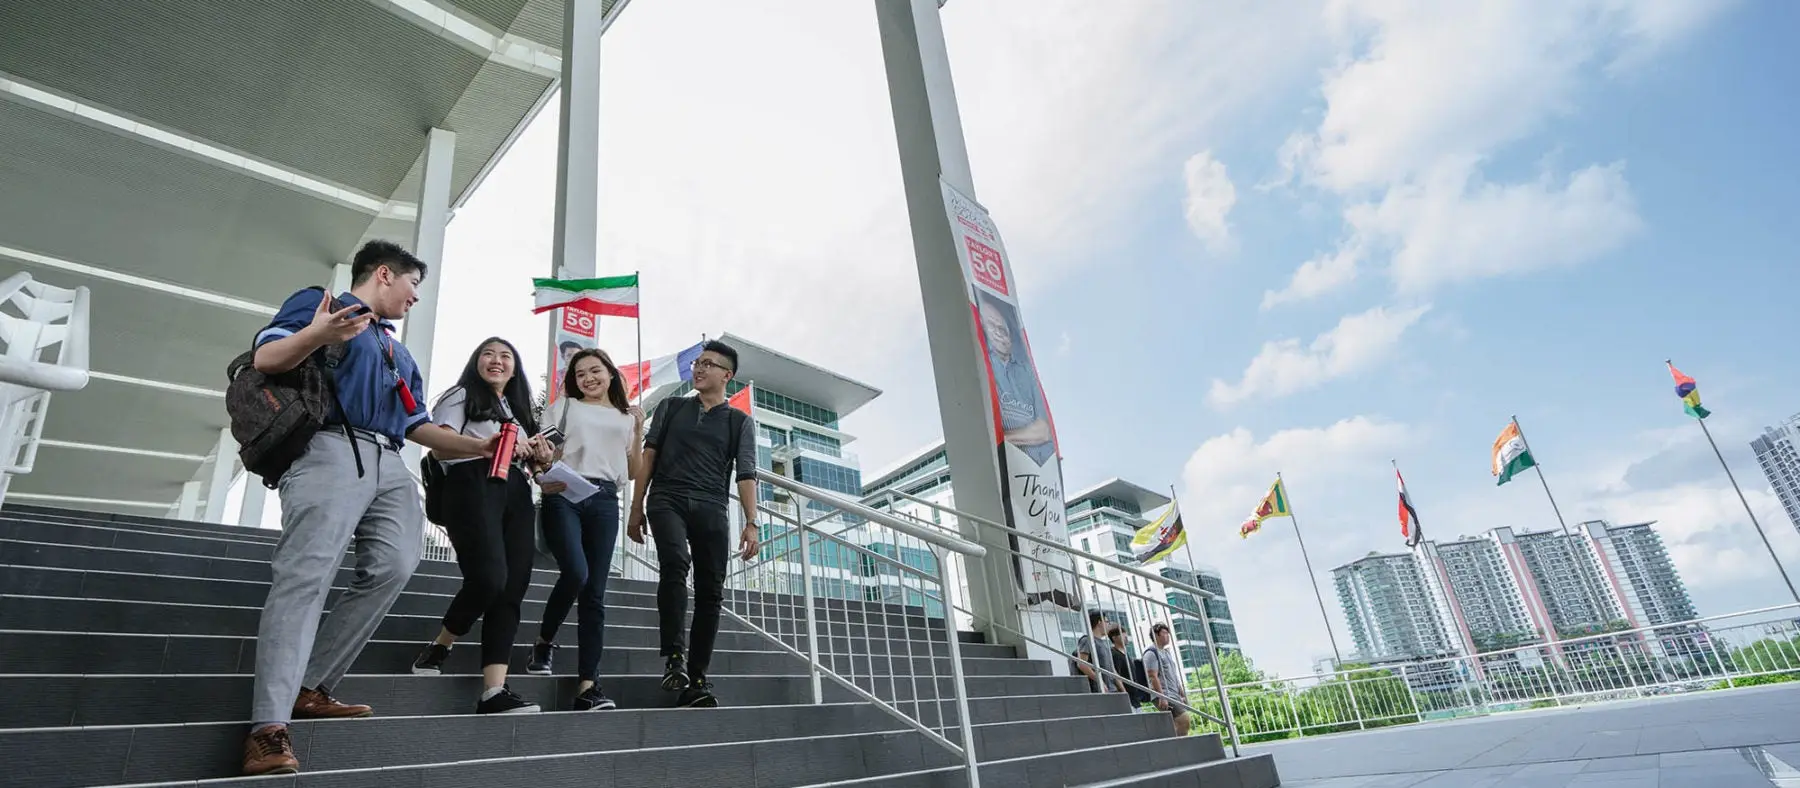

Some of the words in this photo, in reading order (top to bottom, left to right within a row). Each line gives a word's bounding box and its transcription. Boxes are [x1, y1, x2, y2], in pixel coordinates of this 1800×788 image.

[970, 250, 1001, 280] 50
[566, 312, 592, 330] 50
[1001, 391, 1035, 418] Caring
[1015, 474, 1061, 501] Thank
[1028, 499, 1061, 527] You
[1031, 544, 1041, 559] of
